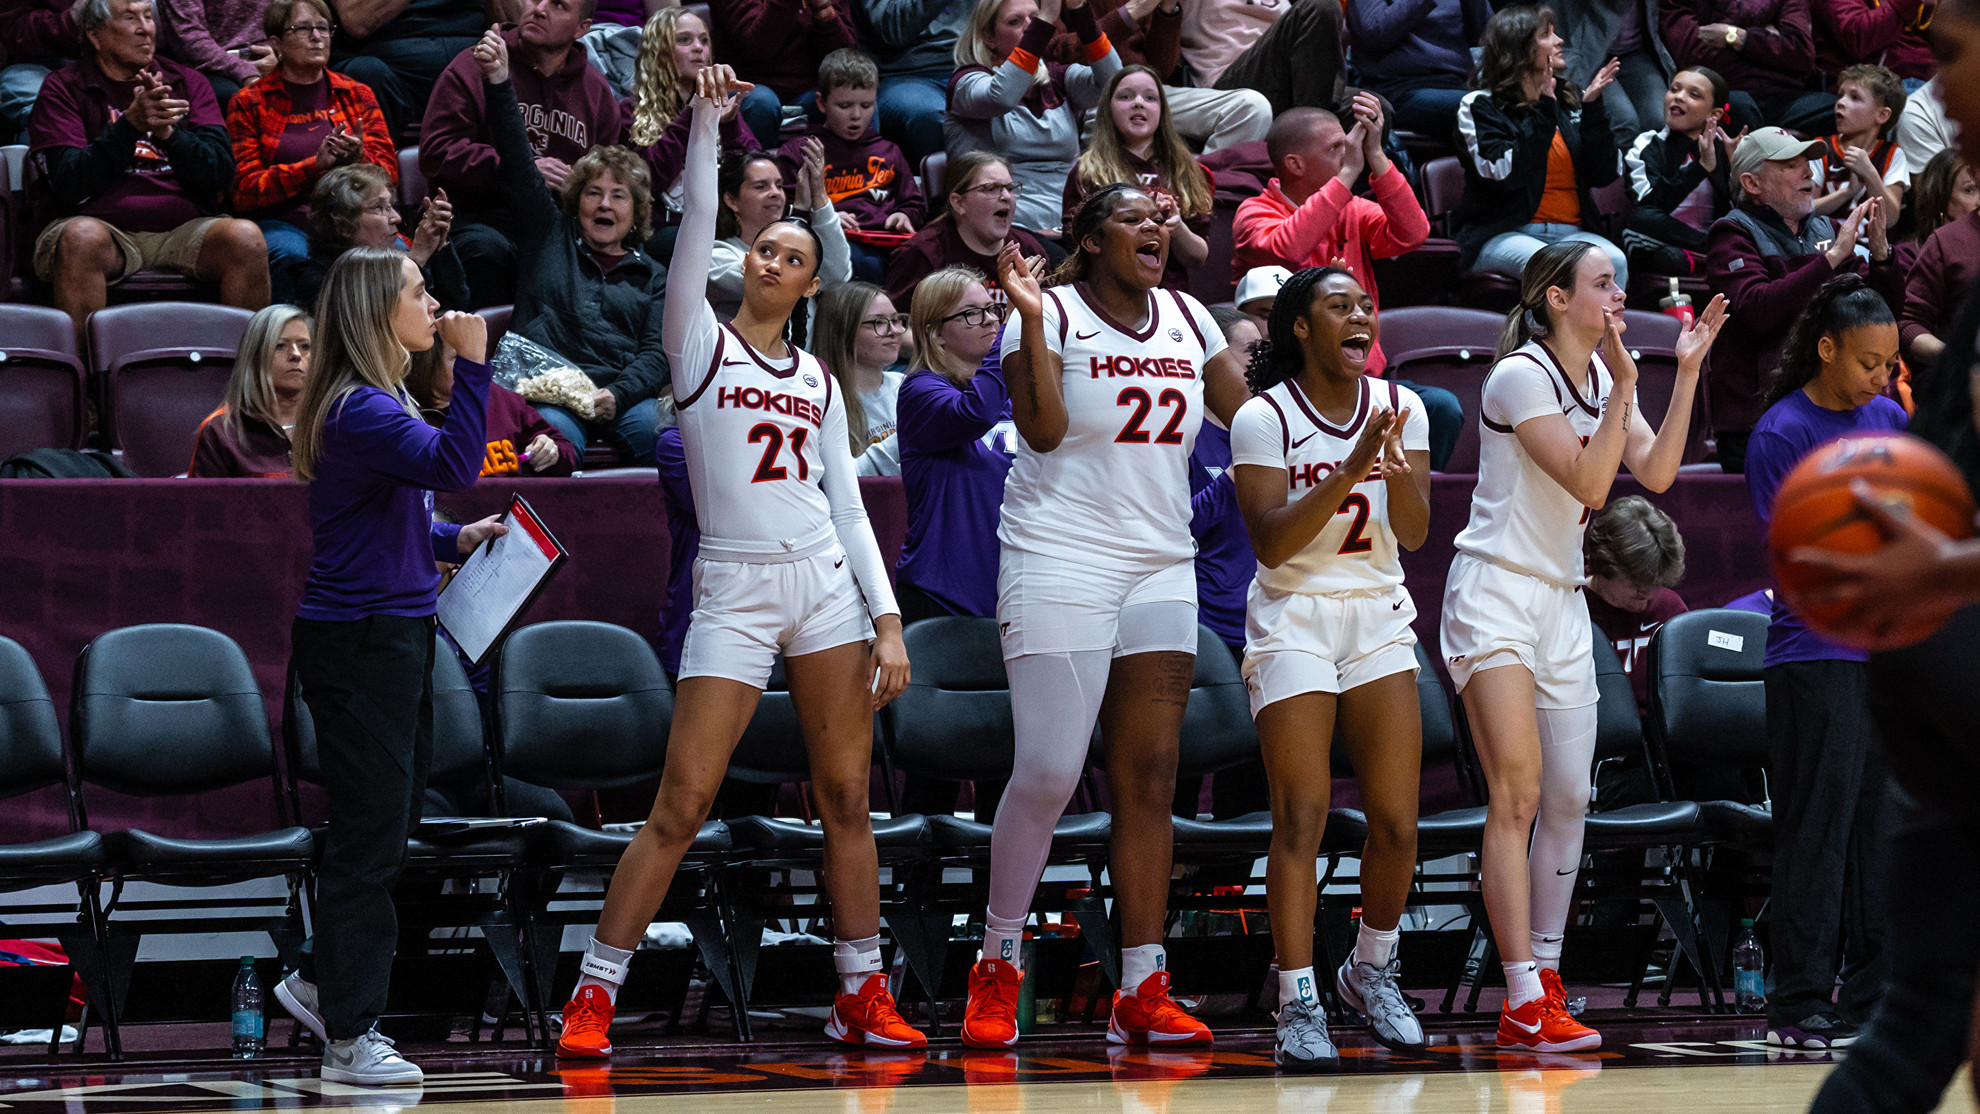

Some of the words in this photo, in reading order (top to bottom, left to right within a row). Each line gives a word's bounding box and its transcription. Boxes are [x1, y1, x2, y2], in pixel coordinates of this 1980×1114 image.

[1090, 355, 1196, 380] HOKIES
[717, 386, 822, 430] HOKIES
[1114, 386, 1187, 445] 22
[747, 422, 809, 483] 21
[1337, 492, 1372, 555] 2
